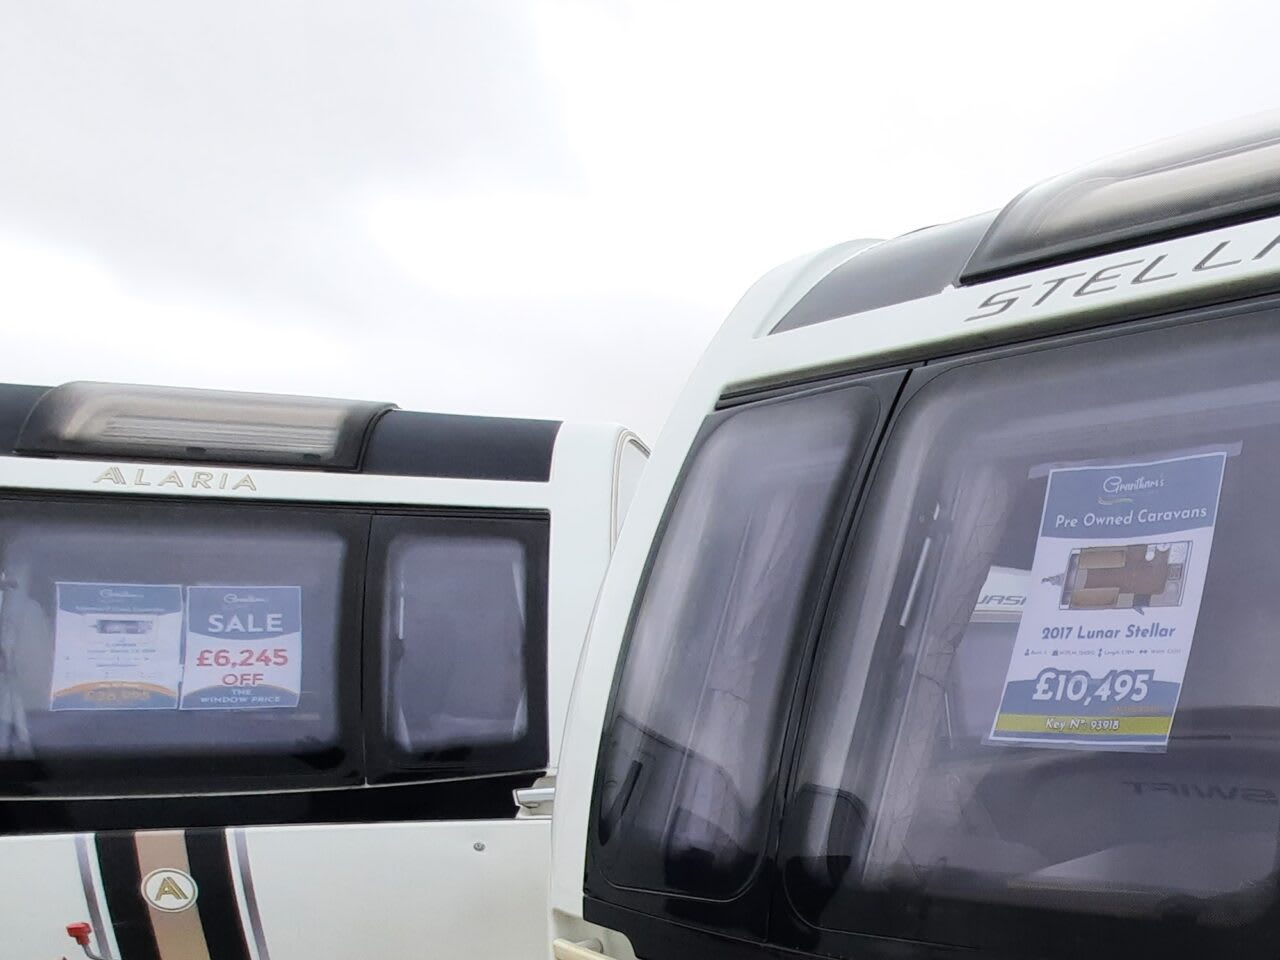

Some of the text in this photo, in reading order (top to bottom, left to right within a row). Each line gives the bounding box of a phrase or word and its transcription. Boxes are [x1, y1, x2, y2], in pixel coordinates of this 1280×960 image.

[93, 466, 257, 491] ALARIA
[1055, 507, 1208, 528] Pre Owned Caravans
[207, 613, 283, 633] SALE
[1042, 622, 1176, 640] 2017 Lunar Stellar
[196, 648, 288, 668] £6,245
[222, 673, 264, 686] OFF
[1032, 670, 1151, 706] £10,495
[1046, 718, 1066, 731] Key
